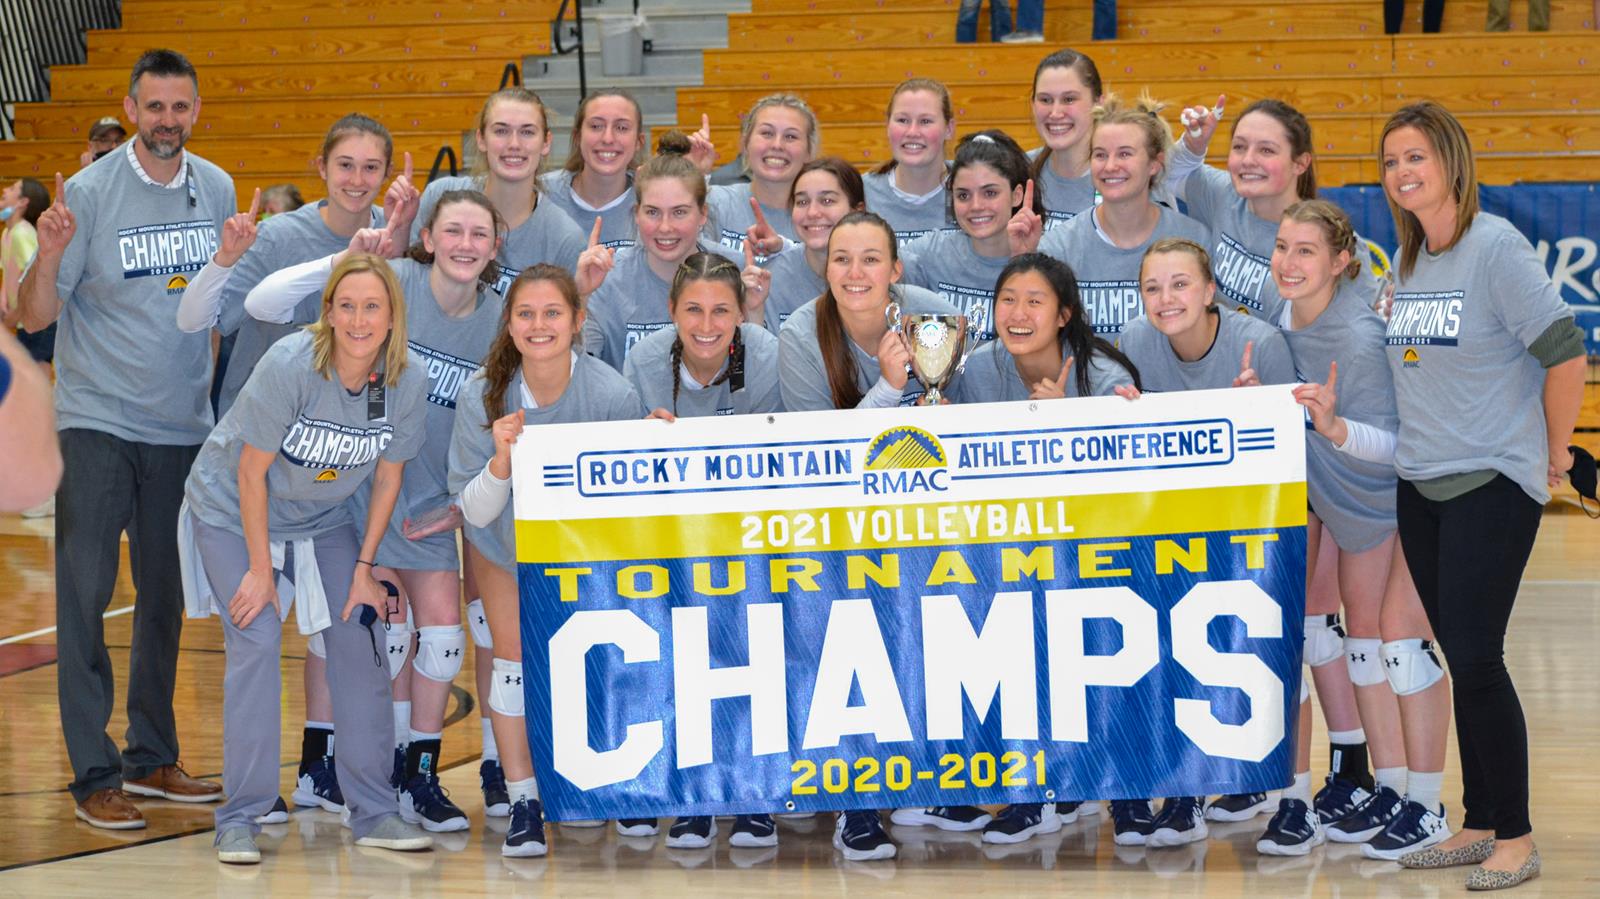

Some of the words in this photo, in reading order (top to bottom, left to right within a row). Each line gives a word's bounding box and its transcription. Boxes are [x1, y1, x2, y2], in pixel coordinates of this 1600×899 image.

[118, 228, 138, 236] ROCKY
[138, 225, 165, 234] MOUNTAIN
[119, 228, 218, 271] CHAMPIONS
[1215, 241, 1271, 301] CHAMPI
[167, 287, 187, 296] RMA
[957, 287, 988, 297] MOUNTAIN
[1222, 286, 1264, 311] 2020-202
[1386, 298, 1463, 337] HAMPIONS
[431, 351, 456, 363] ATHLETIC
[1389, 337, 1431, 346] 2020-2021
[313, 419, 341, 431] MOUNTAIN
[590, 456, 690, 487] ROCKY
[704, 449, 852, 481] MOUNTAIN
[957, 438, 1064, 469] ATHLETIC
[1071, 428, 1224, 462] CONFERENCE
[863, 469, 949, 496] RMAC
[740, 512, 831, 549] 2021
[846, 500, 1075, 546] VOLLEYBALL
[543, 533, 1280, 602] TOURNAMENT
[547, 578, 1286, 792] CHAMPS
[790, 749, 1047, 797] 2020-2021
